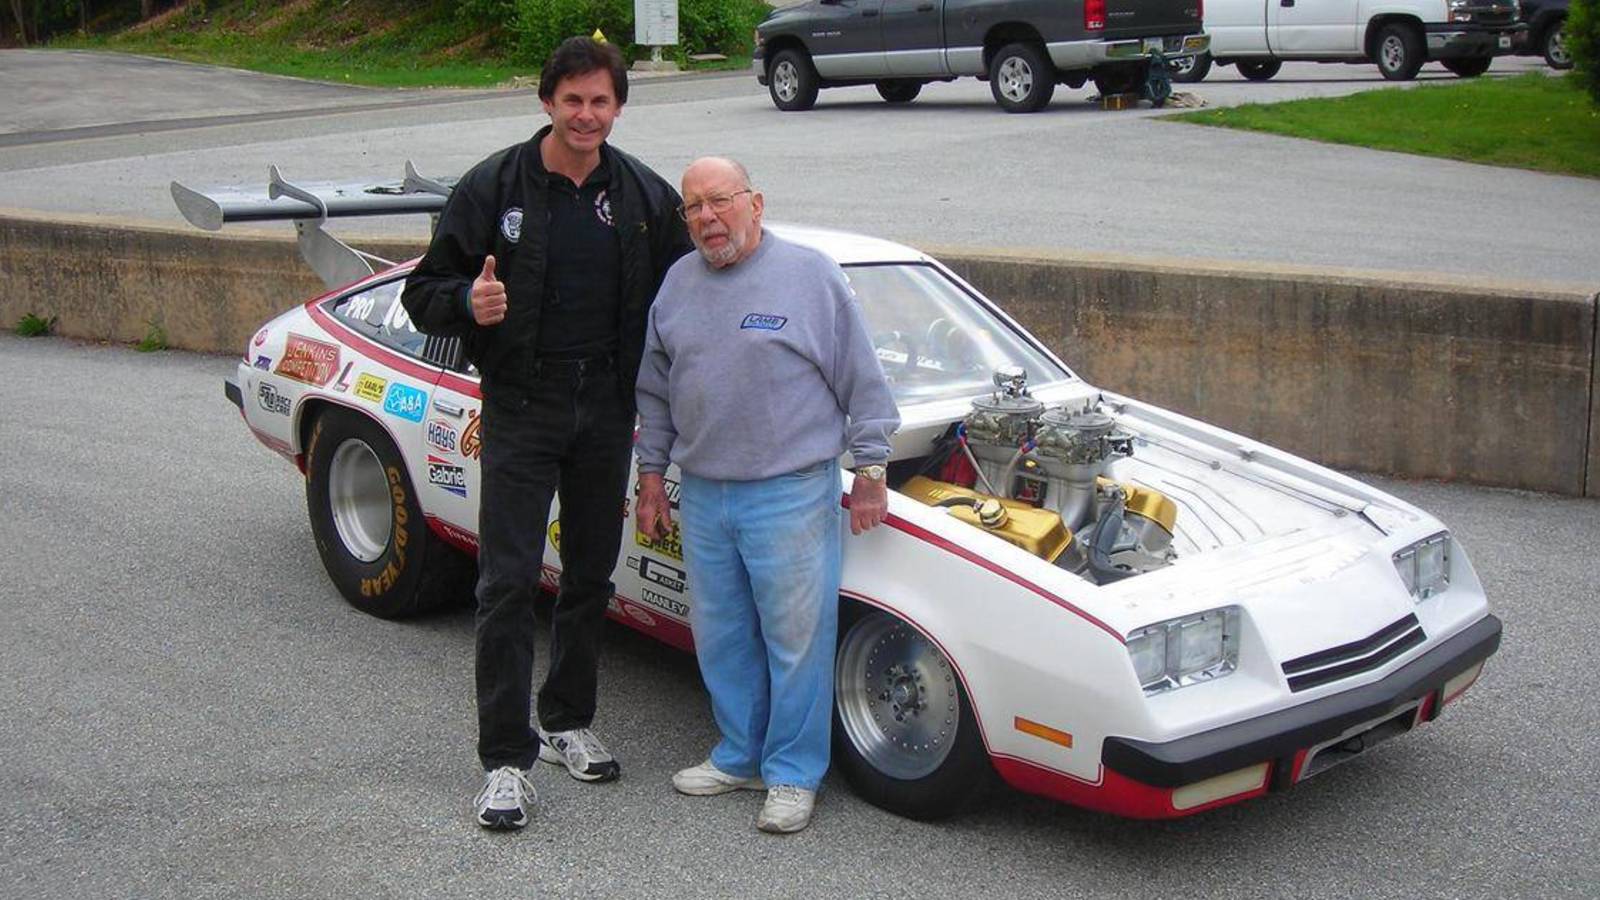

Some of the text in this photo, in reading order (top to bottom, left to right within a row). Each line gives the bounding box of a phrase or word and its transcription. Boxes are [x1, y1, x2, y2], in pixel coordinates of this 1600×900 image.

[345, 297, 375, 320] PRO
[286, 341, 337, 361] JENKINS
[429, 465, 465, 487] Gabriel
[360, 466, 408, 597] GOODYEAR
[642, 588, 687, 617] MANLEY
